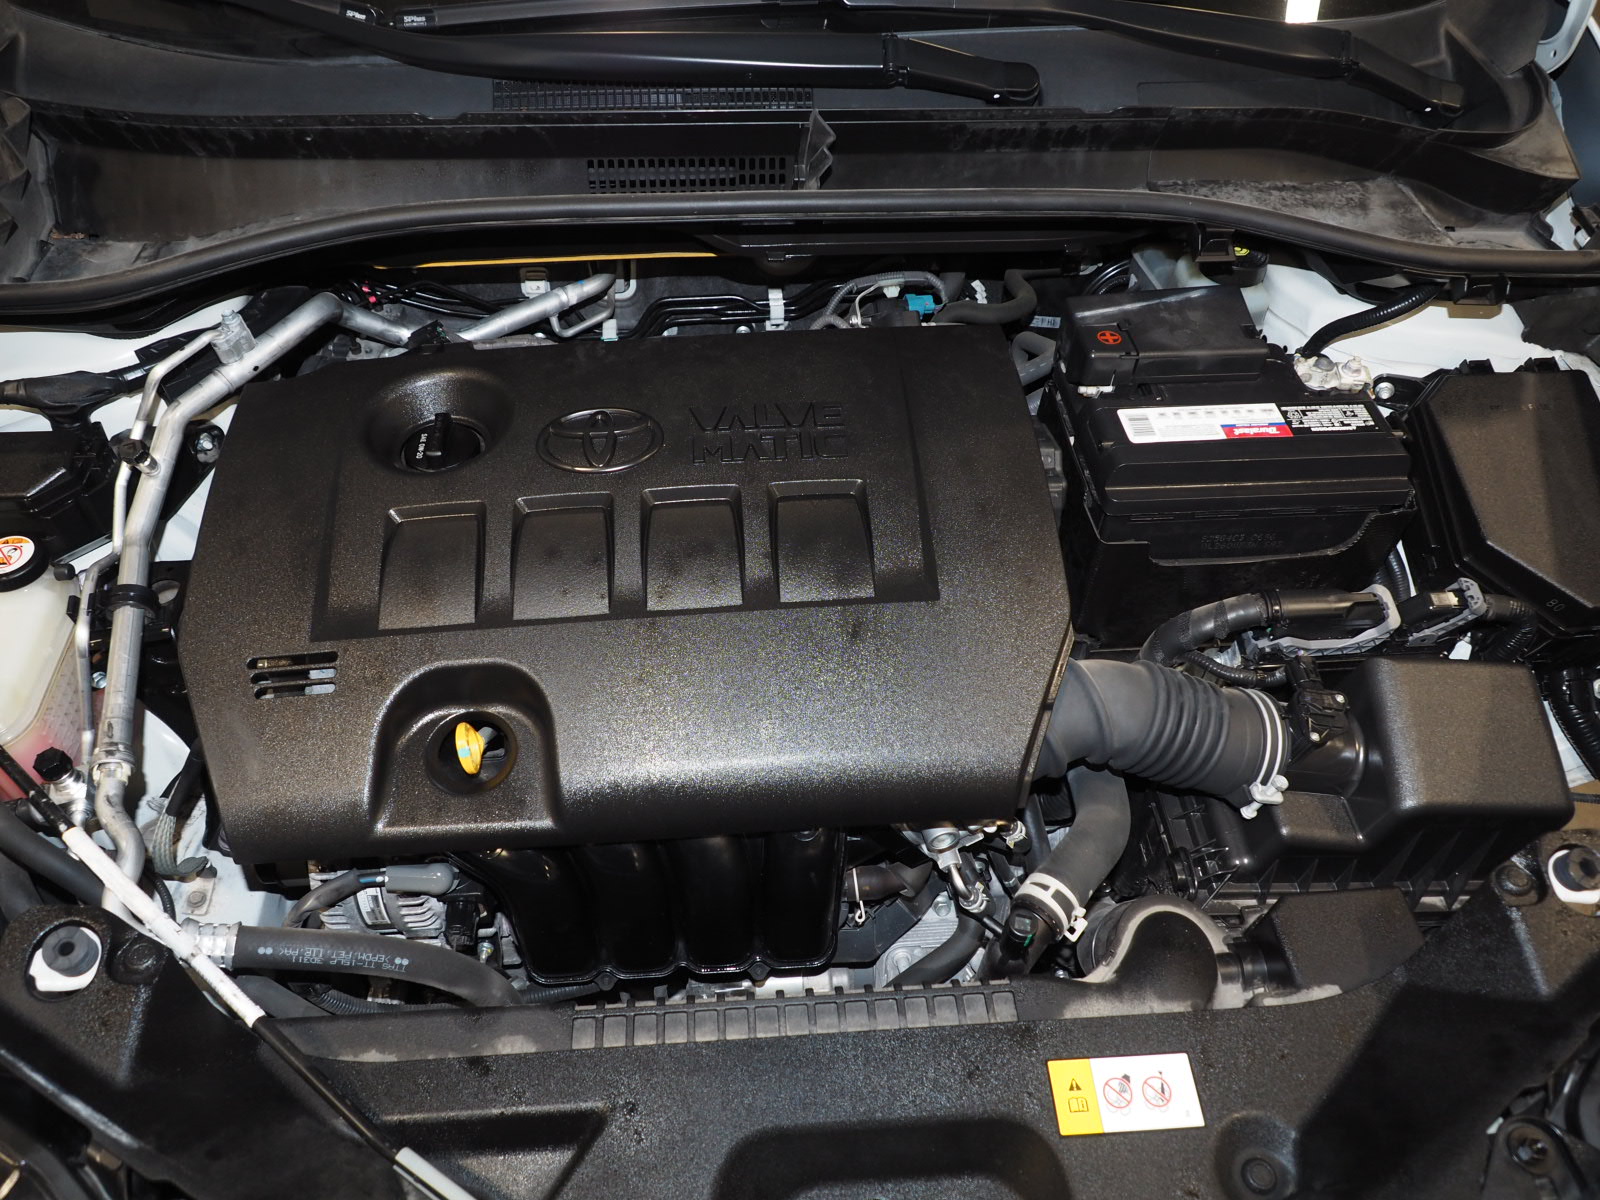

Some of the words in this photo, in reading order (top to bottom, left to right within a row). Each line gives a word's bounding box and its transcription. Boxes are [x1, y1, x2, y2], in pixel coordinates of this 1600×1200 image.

[689, 402, 845, 433] VALVE
[1233, 426, 1280, 436] Duralast
[692, 433, 848, 465] MATIC
